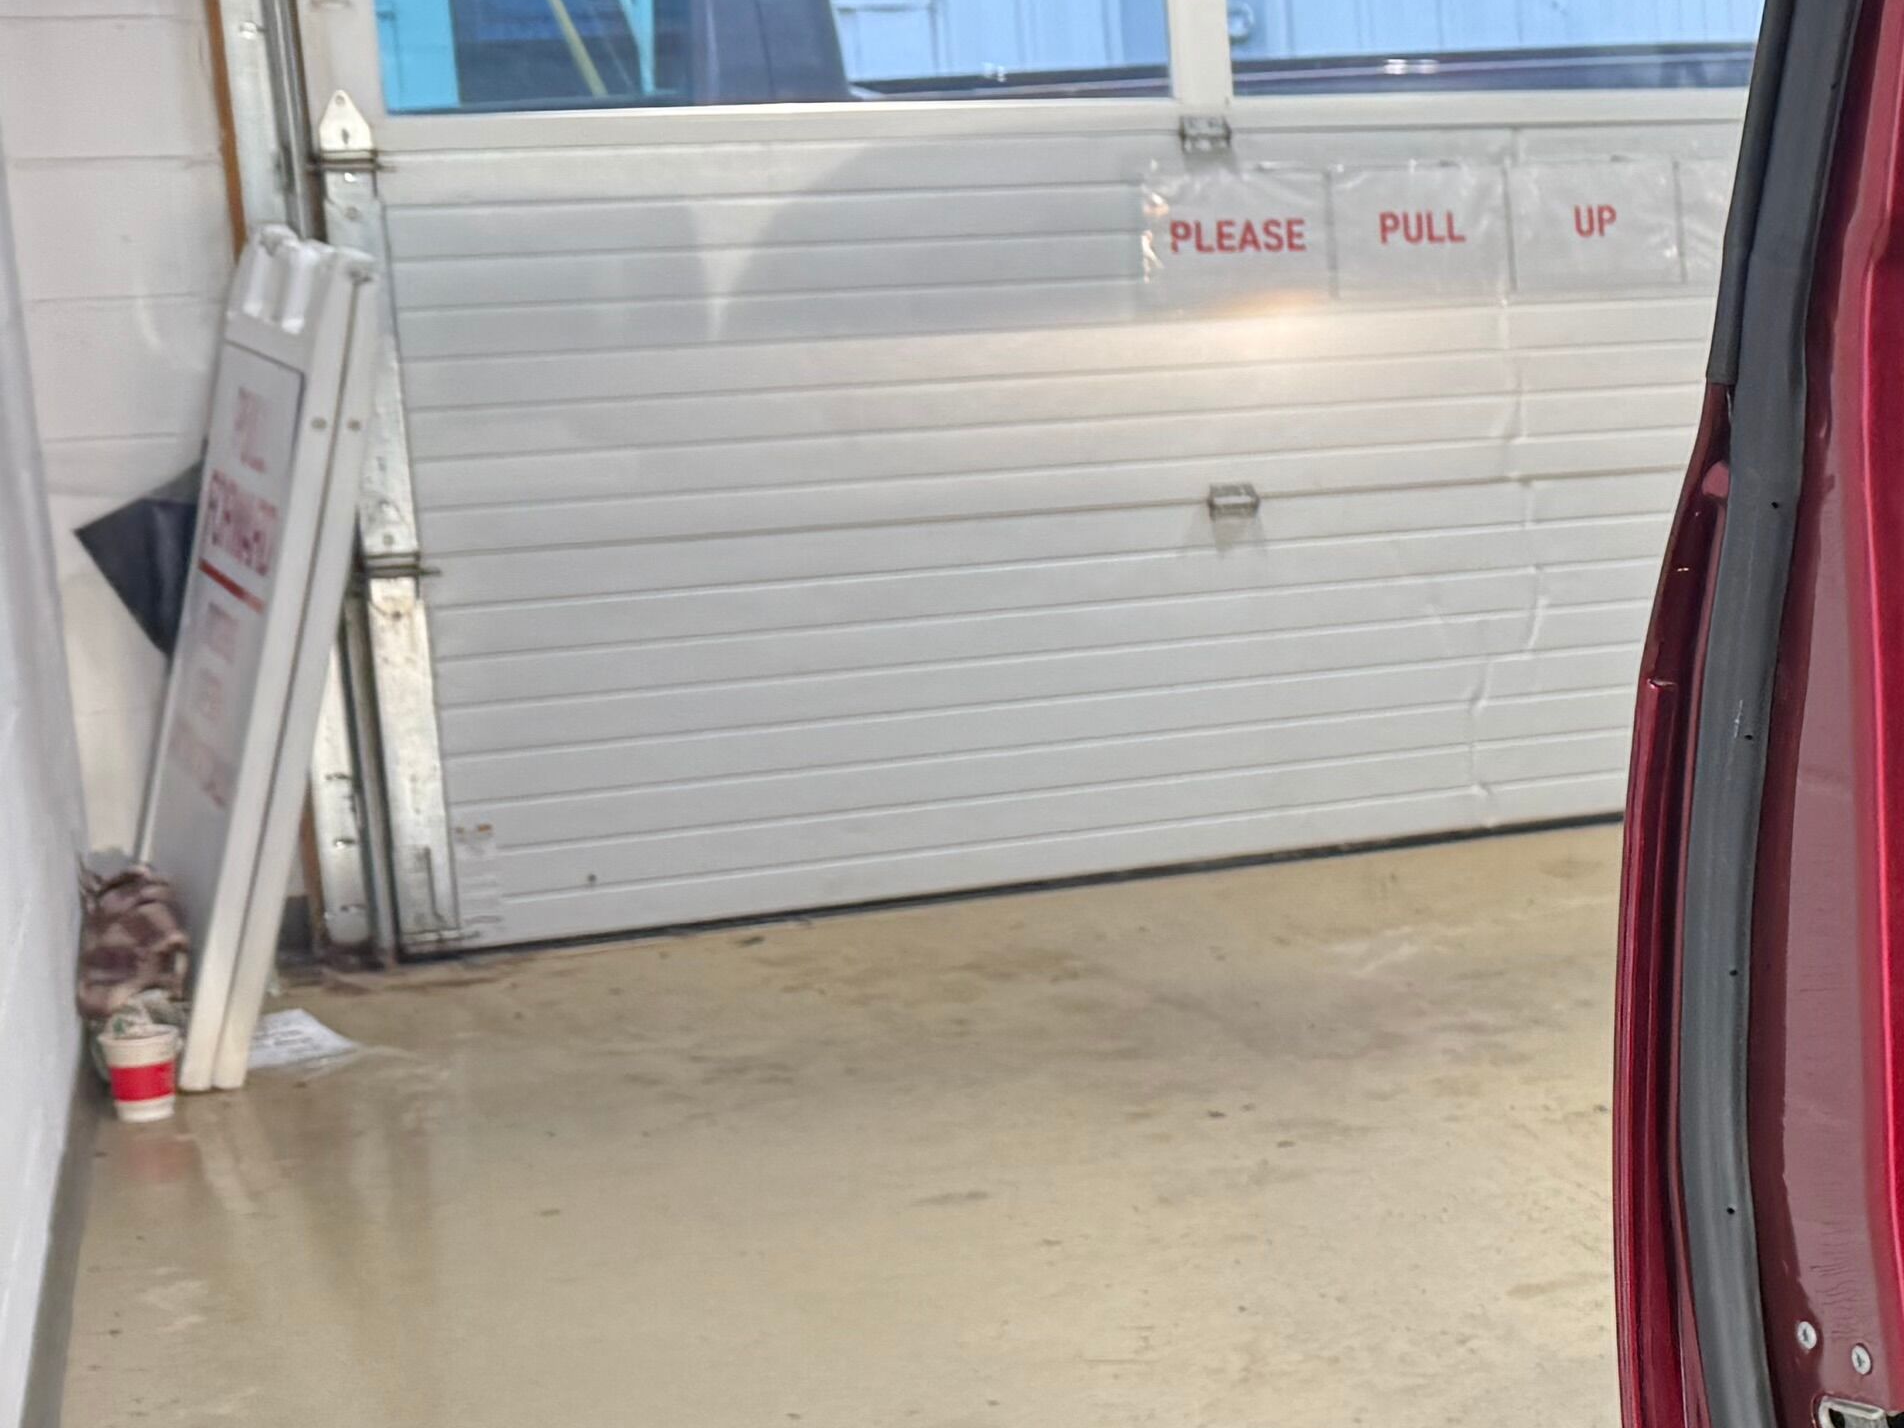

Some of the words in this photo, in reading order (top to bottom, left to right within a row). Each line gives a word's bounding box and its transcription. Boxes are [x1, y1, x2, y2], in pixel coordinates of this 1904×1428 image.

[1170, 217, 1306, 253] PLEASE
[1379, 210, 1465, 244] PULL
[1573, 204, 1617, 238] UP
